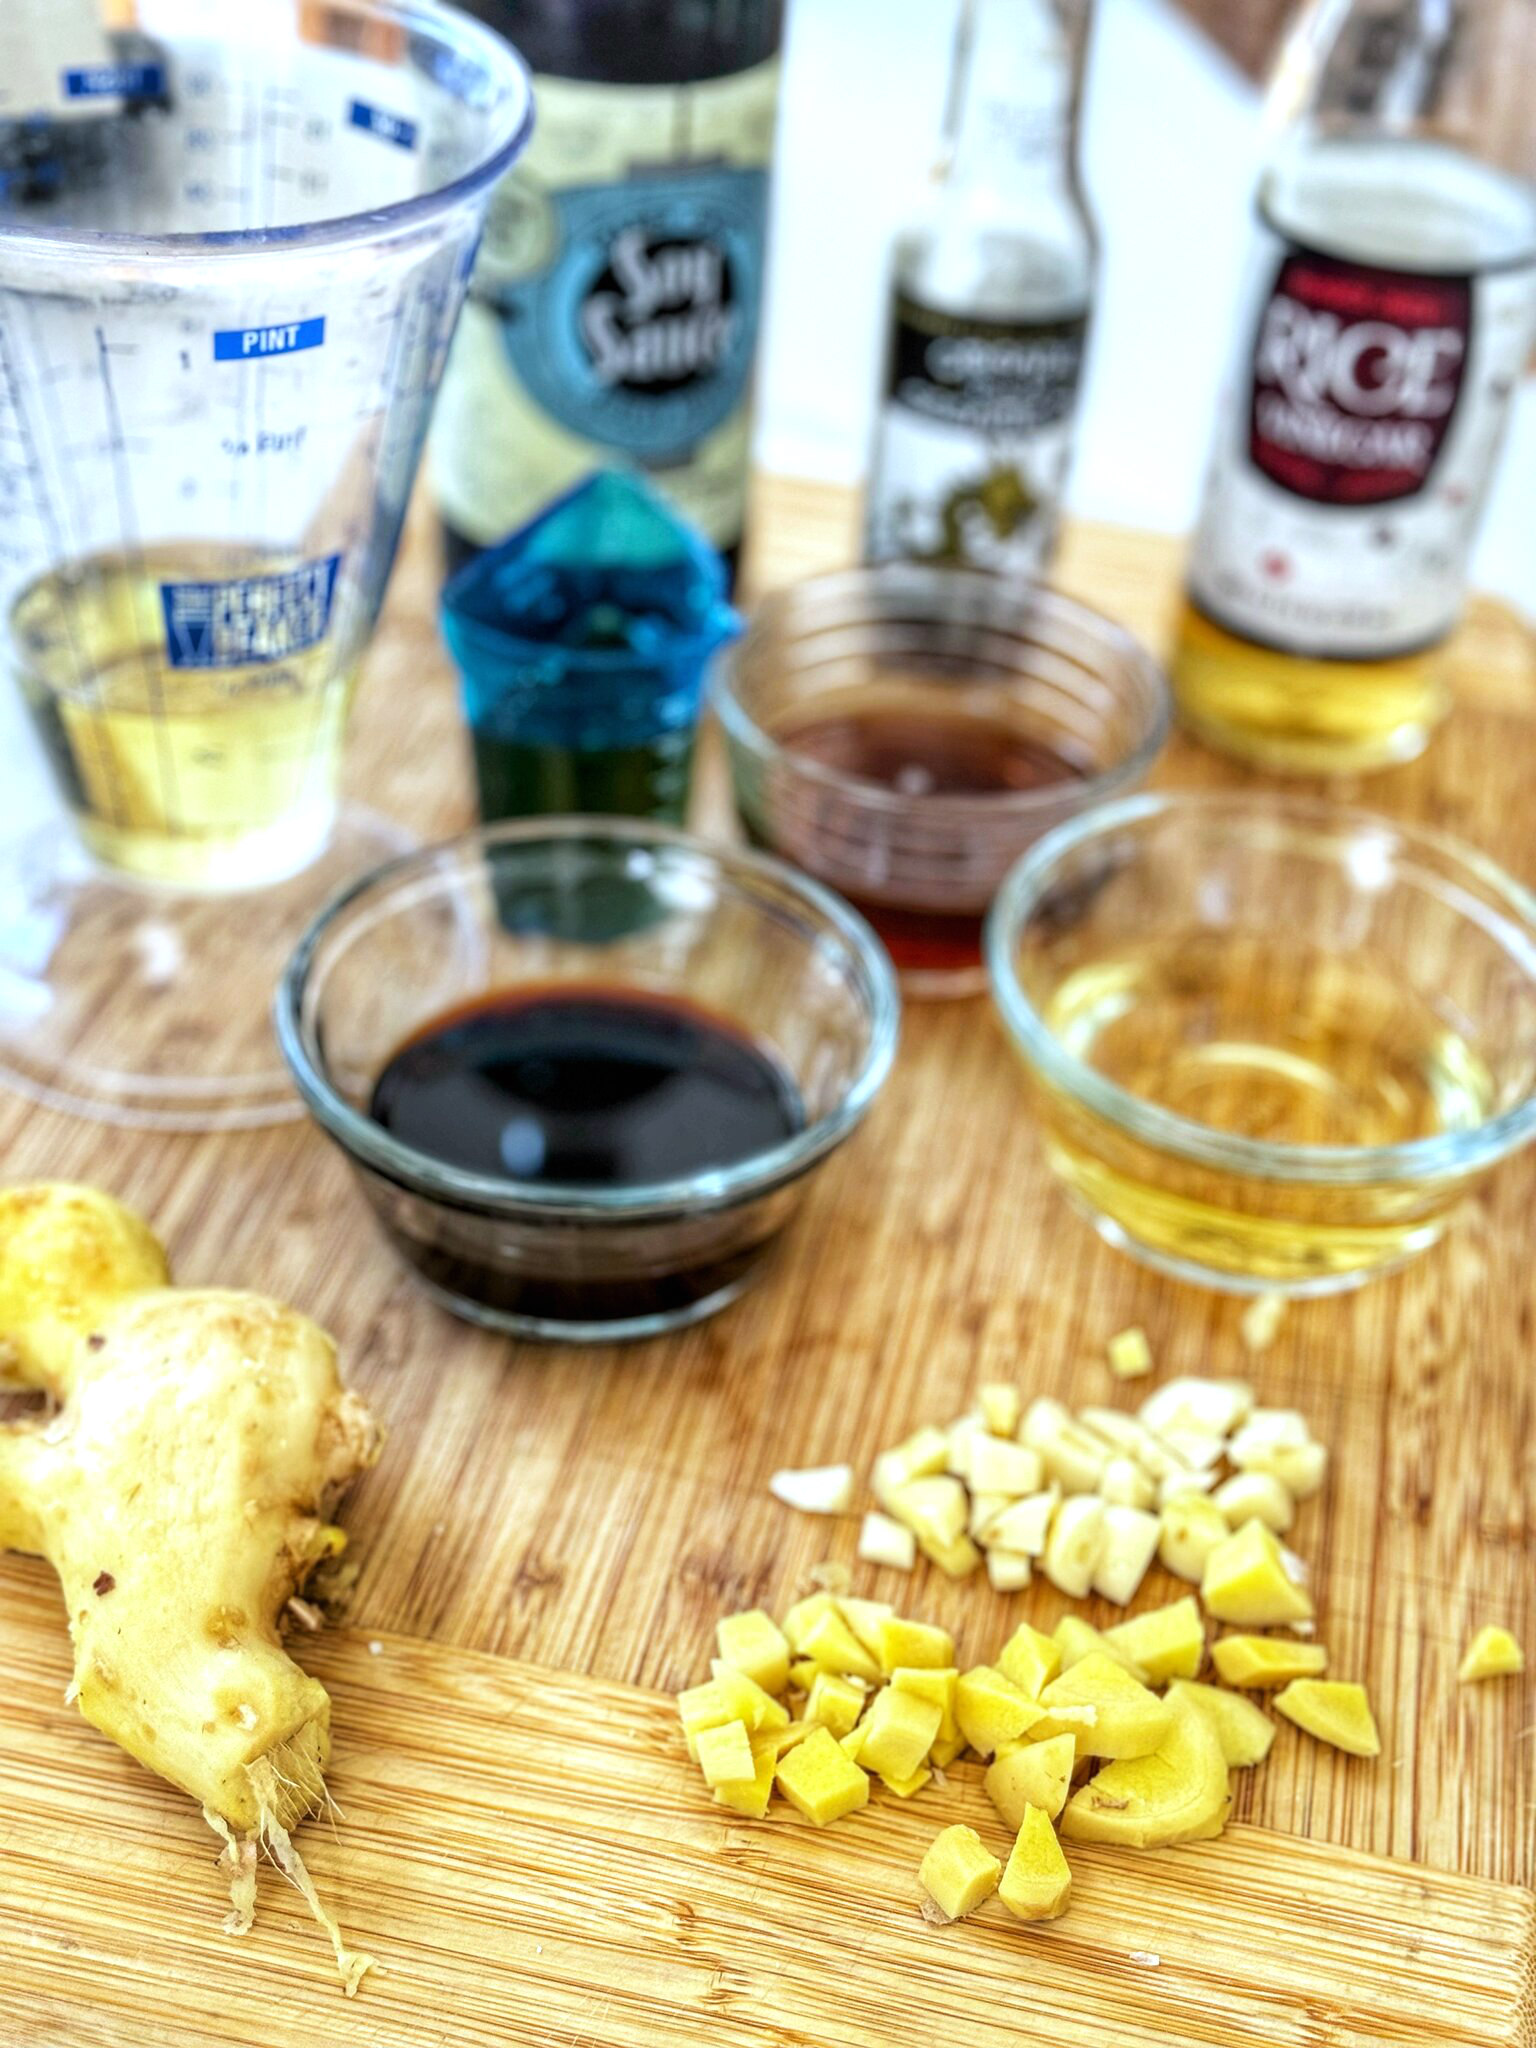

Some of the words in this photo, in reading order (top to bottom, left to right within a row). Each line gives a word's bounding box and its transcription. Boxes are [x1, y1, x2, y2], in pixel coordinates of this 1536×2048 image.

[610, 225, 728, 322] Soy
[242, 325, 300, 355] PINT
[1256, 294, 1463, 417] RICE
